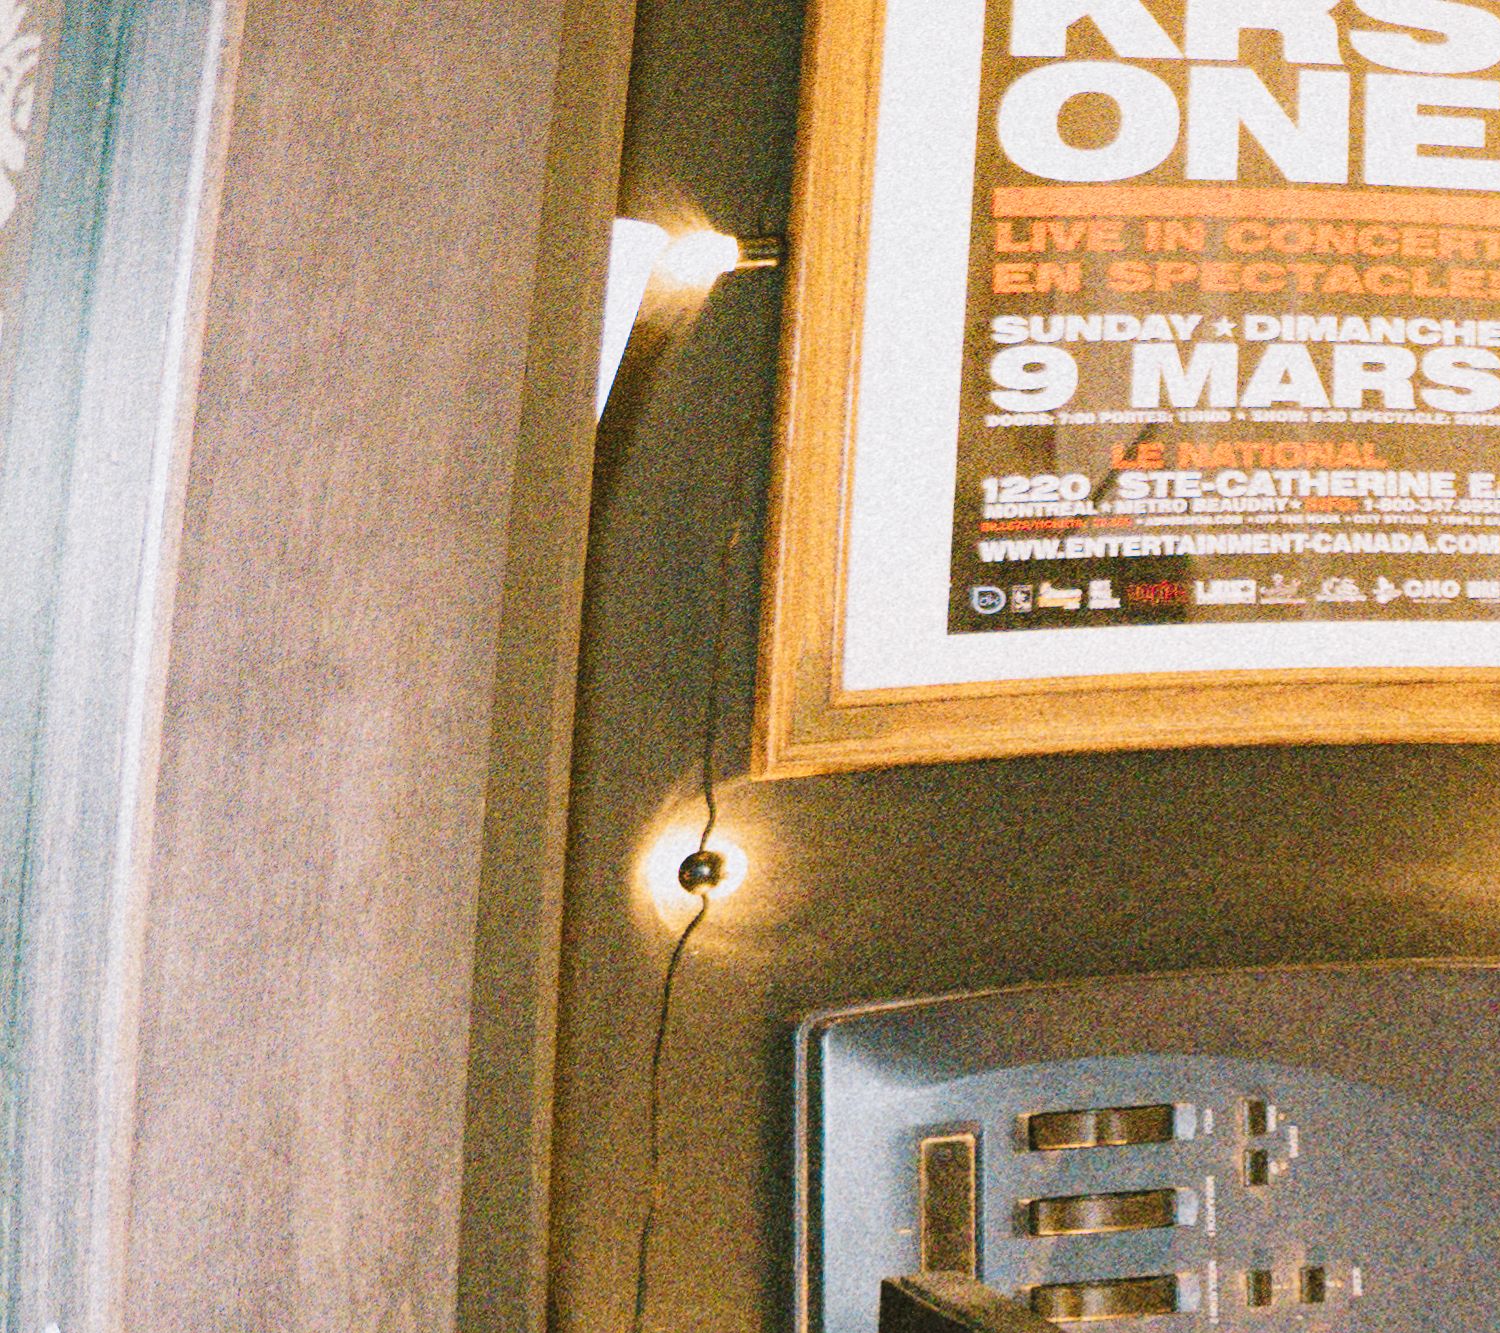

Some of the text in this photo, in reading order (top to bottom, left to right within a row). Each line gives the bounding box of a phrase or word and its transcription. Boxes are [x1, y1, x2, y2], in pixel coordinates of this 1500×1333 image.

[994, 221, 1127, 253] LIVE
[1144, 221, 1206, 252] IN
[992, 261, 1081, 294] EN
[991, 313, 1204, 344] SUNDAY
[990, 344, 1079, 413] 9
[1111, 441, 1388, 470] LE NATIONAL
[981, 473, 1092, 504] 1220
[1117, 470, 1457, 499] STE-CATHERINE
